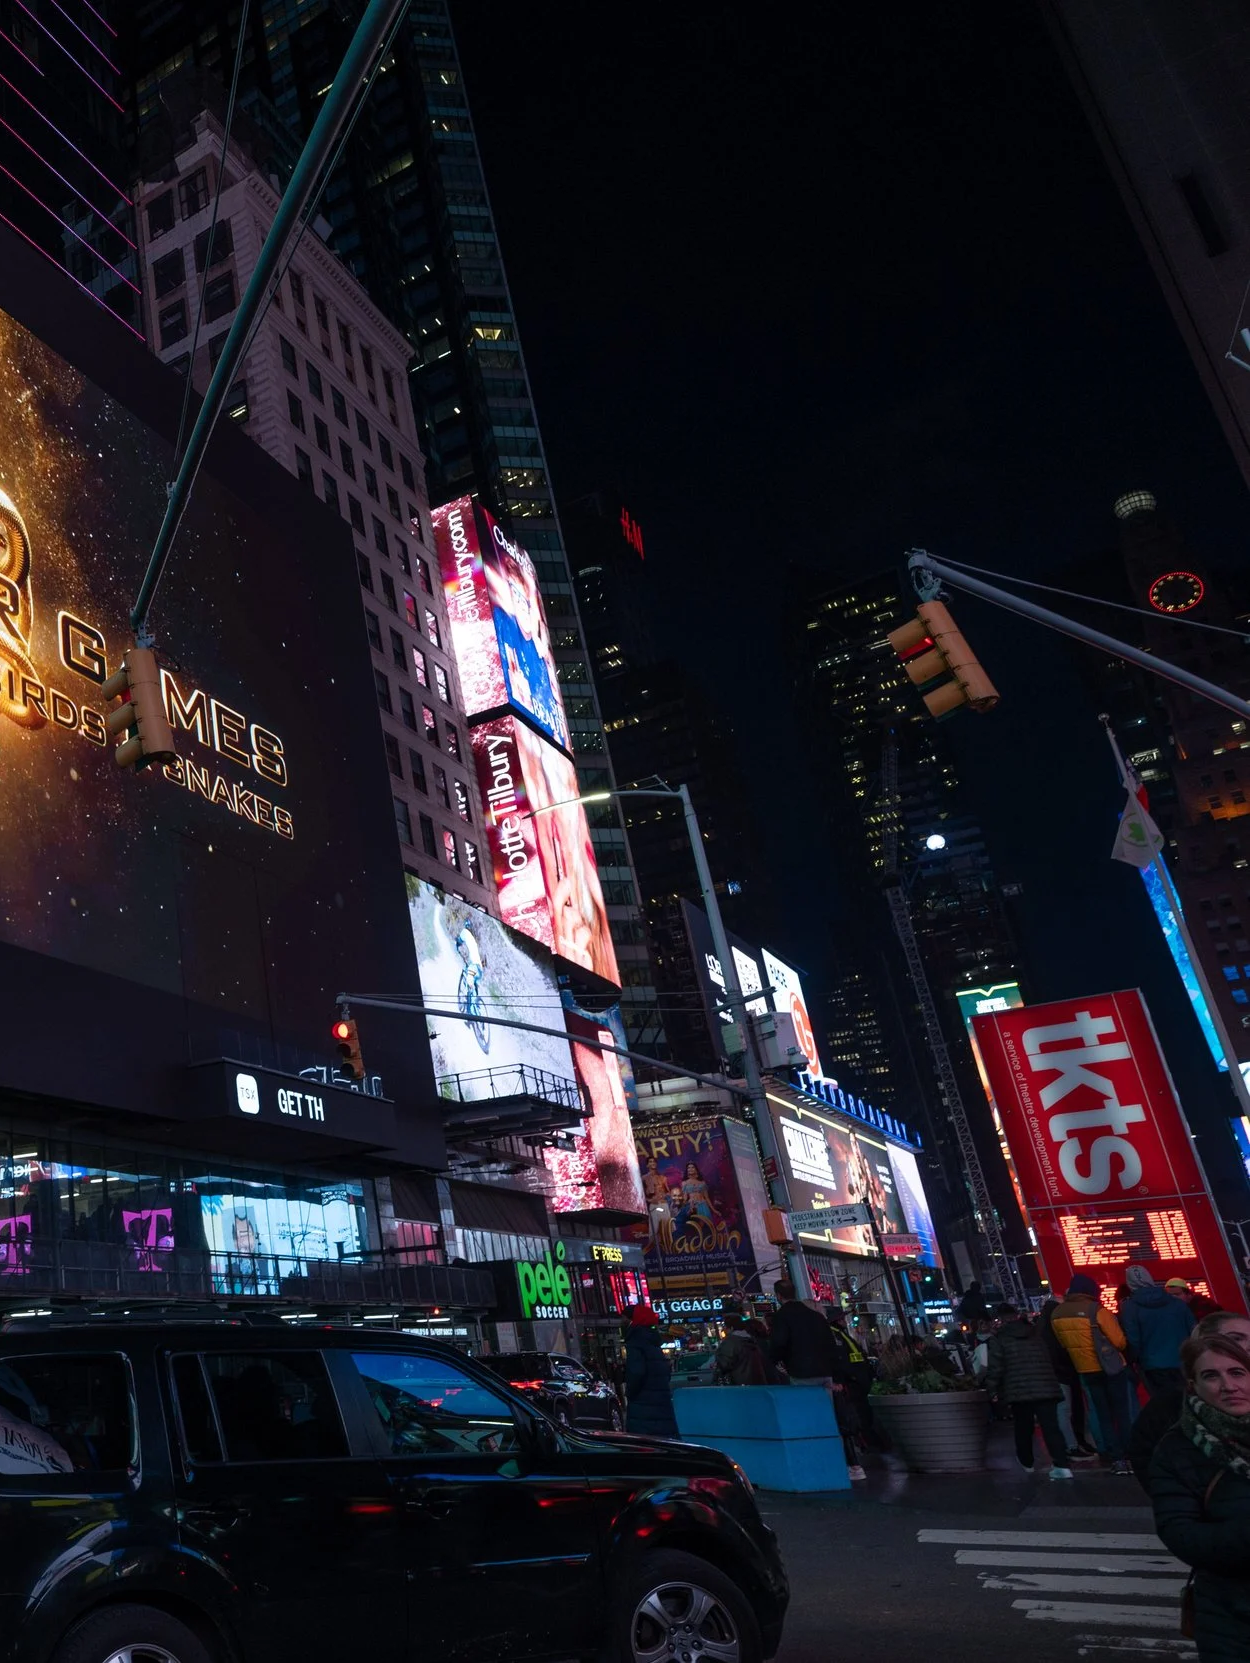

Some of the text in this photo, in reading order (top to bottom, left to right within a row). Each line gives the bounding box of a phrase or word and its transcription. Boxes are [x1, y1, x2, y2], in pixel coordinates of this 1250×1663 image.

[57, 609, 289, 788] GMES
[161, 754, 295, 841] SNAKES
[1005, 1039, 1021, 1070] service
[1015, 1071, 1027, 1082] of
[239, 1087, 325, 1122] TSX GET TH
[1019, 1083, 1035, 1115] theatre
[1021, 1010, 1146, 1196] tkts
[671, 1120, 718, 1135] BIGGEST
[1029, 1117, 1055, 1175] development
[1047, 1177, 1062, 1197] fund
[791, 1206, 857, 1222] PEDESTRIAN FLOW ZONE
[794, 1219, 829, 1230] KEEP MOVING
[535, 1306, 570, 1319] SOCCER
